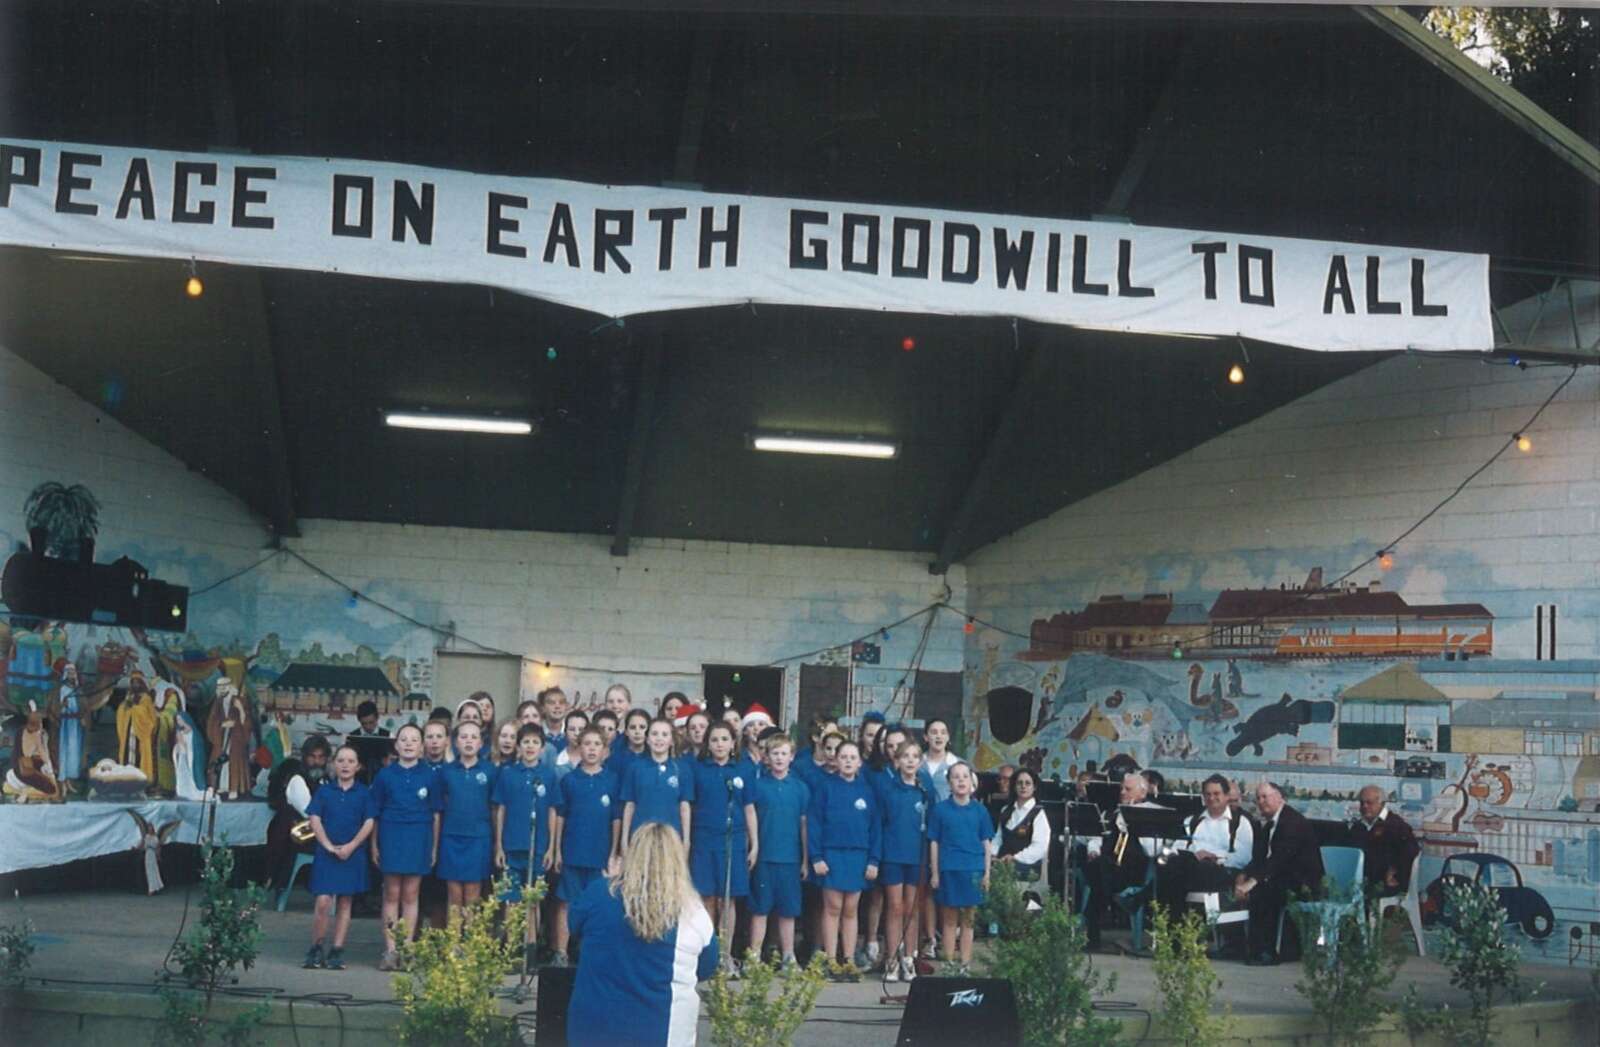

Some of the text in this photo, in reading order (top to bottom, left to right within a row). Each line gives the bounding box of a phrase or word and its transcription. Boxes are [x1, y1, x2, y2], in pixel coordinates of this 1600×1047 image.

[0, 144, 1449, 316] PEACE ON EARTH GOODWILL TO ALL
